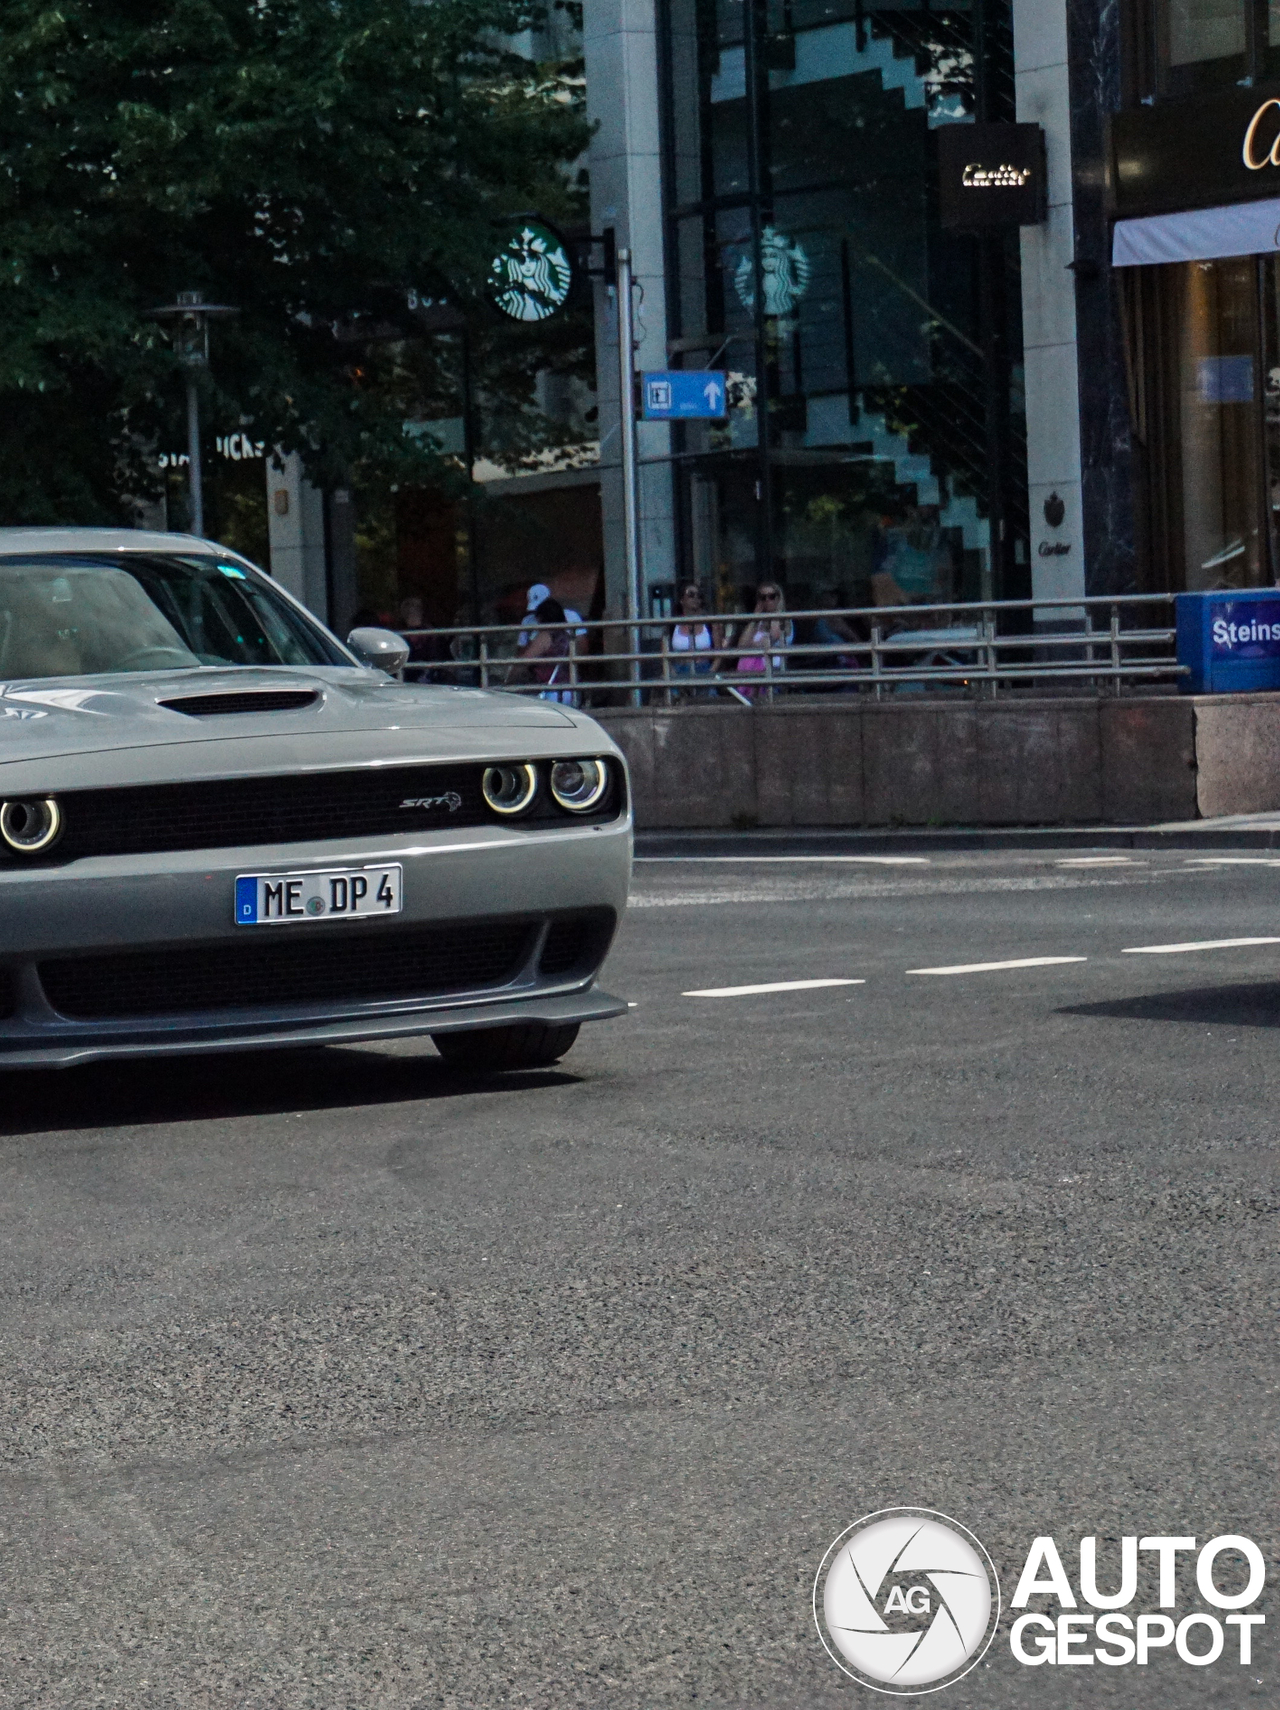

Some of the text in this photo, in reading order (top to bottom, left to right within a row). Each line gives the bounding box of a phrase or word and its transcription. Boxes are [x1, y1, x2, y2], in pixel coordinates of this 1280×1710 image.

[399, 796, 449, 809] SRT
[264, 872, 394, 916] ME DP 4
